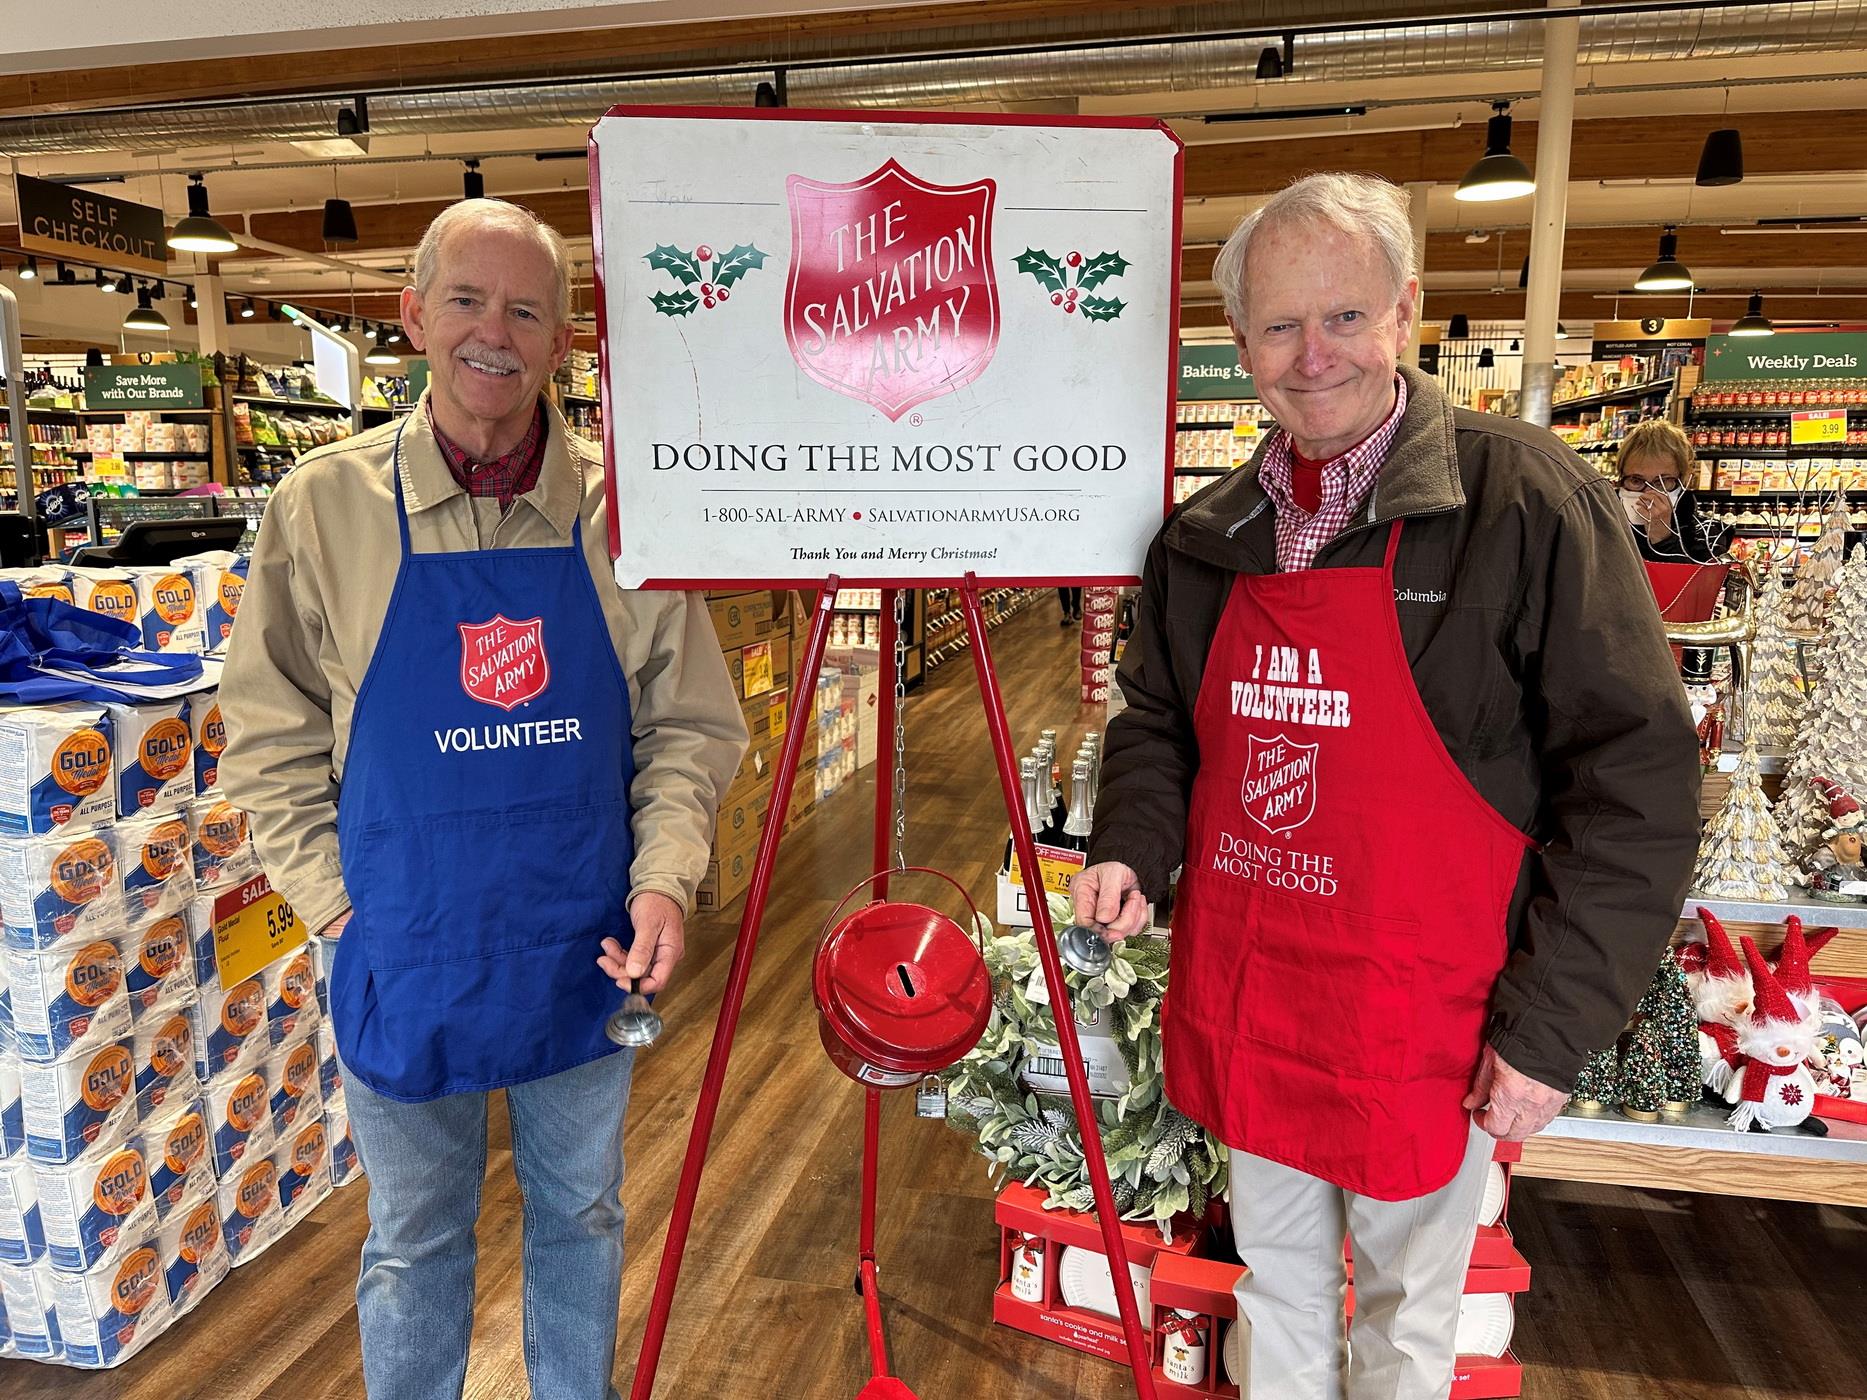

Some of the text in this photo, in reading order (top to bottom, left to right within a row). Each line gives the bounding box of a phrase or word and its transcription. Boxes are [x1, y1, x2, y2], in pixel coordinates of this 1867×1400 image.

[72, 198, 118, 227] SELF
[34, 216, 155, 259] CHECKOUT
[829, 200, 907, 273] THE
[803, 214, 976, 355] SALVATION
[1648, 319, 1657, 332] 3
[866, 285, 970, 393] ARMY
[140, 352, 150, 363] 10
[1747, 354, 1857, 370] Weekly Deals
[116, 374, 167, 386] Save More
[1182, 364, 1253, 380] Baking Sp
[102, 387, 184, 399] with Our Brands
[1822, 424, 1839, 434] 3.99
[651, 443, 1127, 472] DOING THE MOST GOOD
[703, 507, 1080, 523] 1-800-SAL-ARMY SALVATIONARMYUSA.ORG
[790, 546, 998, 564] Thank You and Merry Christmas!
[94, 594, 133, 610] GOLD
[156, 588, 190, 605] GOLD
[222, 584, 244, 598] GOL
[1393, 588, 1447, 603] Columbia
[176, 631, 184, 641] ALL
[475, 625, 507, 656] THE
[468, 627, 536, 687] SALVATION
[1252, 644, 1322, 684] I AM A
[494, 654, 536, 698] ARMY
[1230, 680, 1351, 728] VOLUNTEER
[146, 734, 186, 757] GOLD
[434, 718, 583, 754] VOLUNTEER
[60, 747, 106, 770] GOLD
[1257, 743, 1286, 772] THE
[71, 768, 101, 780] Medal
[1244, 751, 1311, 803] SALVATION
[164, 789, 172, 798] ALL
[174, 782, 192, 796] PURPOSE
[1262, 780, 1308, 822] ARMY
[80, 806, 90, 816] ALL
[90, 800, 113, 813] PURPOSE
[1035, 846, 1050, 856] OFF
[1218, 832, 1334, 876] DOING THE
[58, 853, 111, 882] GOLD
[1058, 872, 1073, 888] 7.9
[1212, 854, 1337, 896] MOST GOOD
[218, 916, 240, 934] Gold Medal
[266, 902, 294, 938] 5.99
[88, 1058, 129, 1092] GOLD
[288, 1054, 312, 1082] GOLD
[101, 1160, 142, 1196] GOLD
[1040, 1314, 1064, 1326] santa's
[1064, 1320, 1088, 1334] cookie
[1088, 1326, 1104, 1338] and
[1104, 1332, 1119, 1343] milk
[1169, 1368, 1189, 1380] milk
